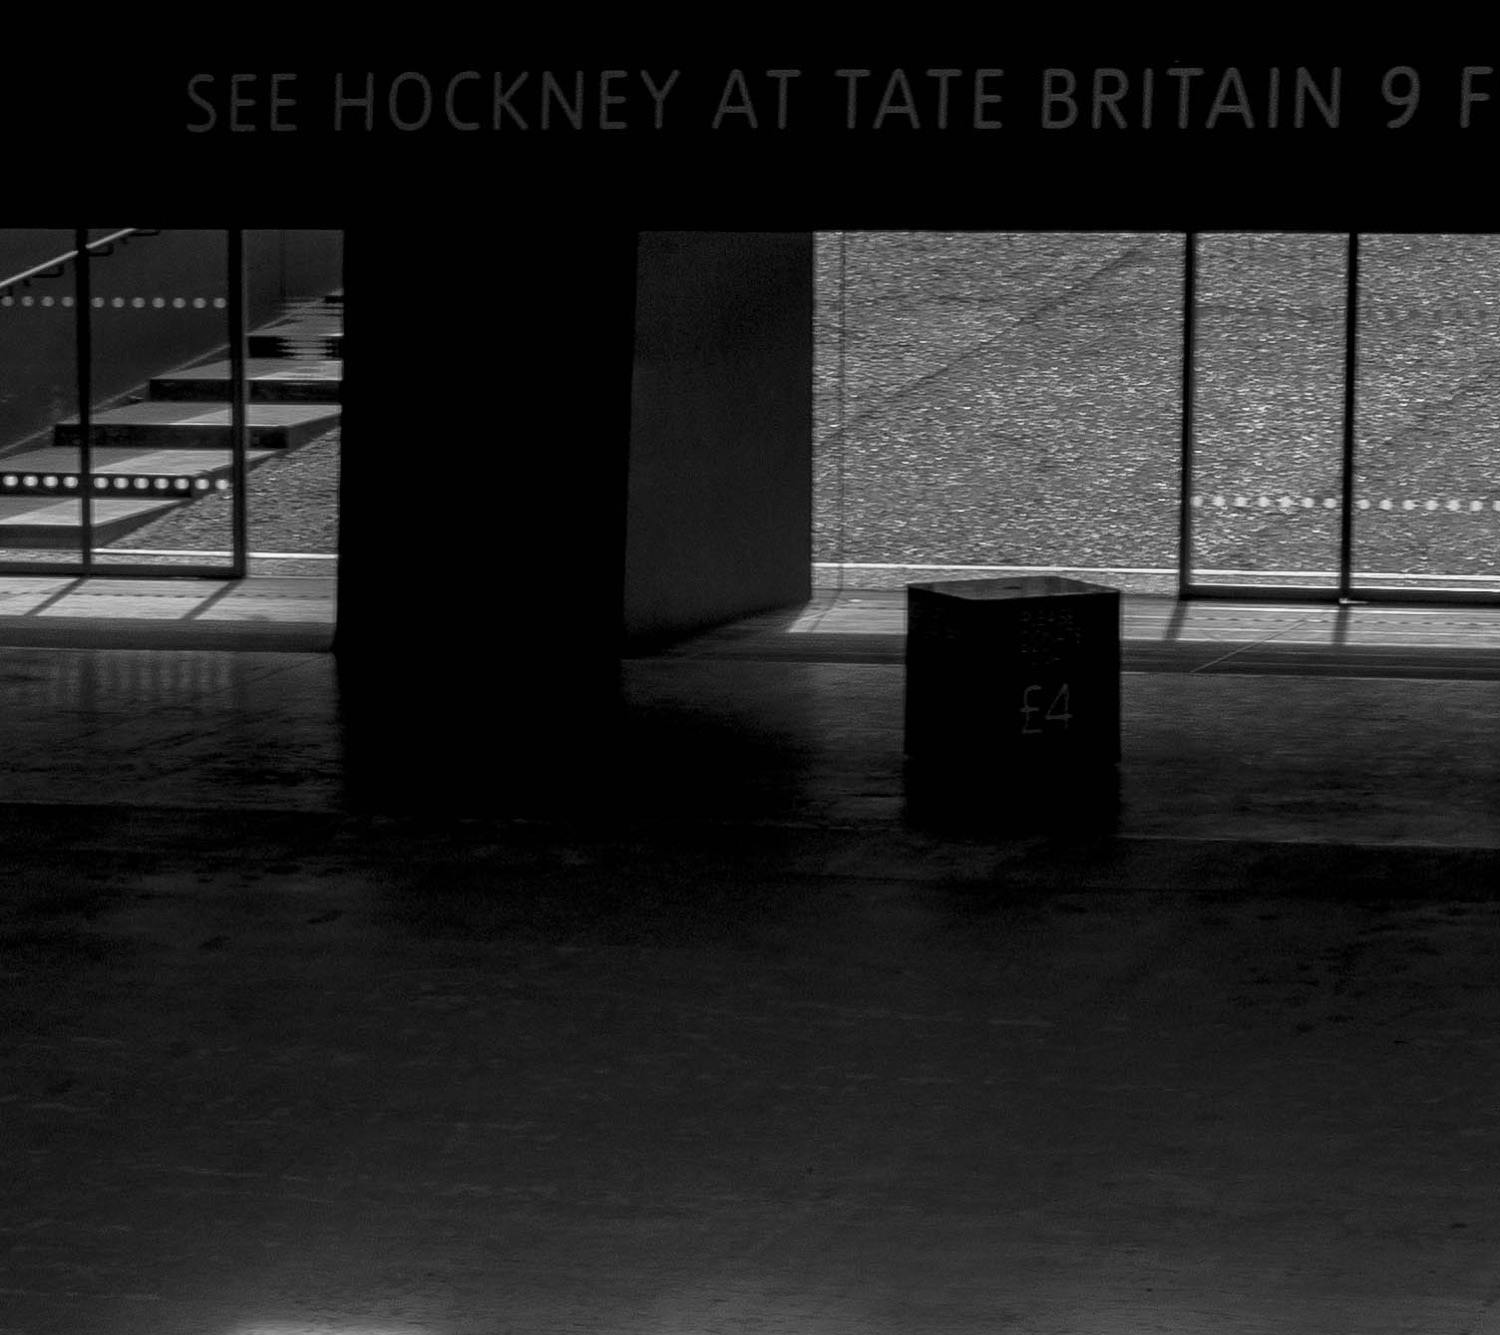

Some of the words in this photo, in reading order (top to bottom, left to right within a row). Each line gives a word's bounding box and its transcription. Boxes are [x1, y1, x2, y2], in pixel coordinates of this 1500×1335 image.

[187, 73, 296, 132] SEE
[335, 69, 679, 130] HOCKNEY
[712, 68, 800, 129] AT
[835, 68, 1003, 129] TATE
[1041, 66, 1340, 129] BRITAIN
[1381, 65, 1419, 128] 9
[1019, 682, 1073, 735] £4
